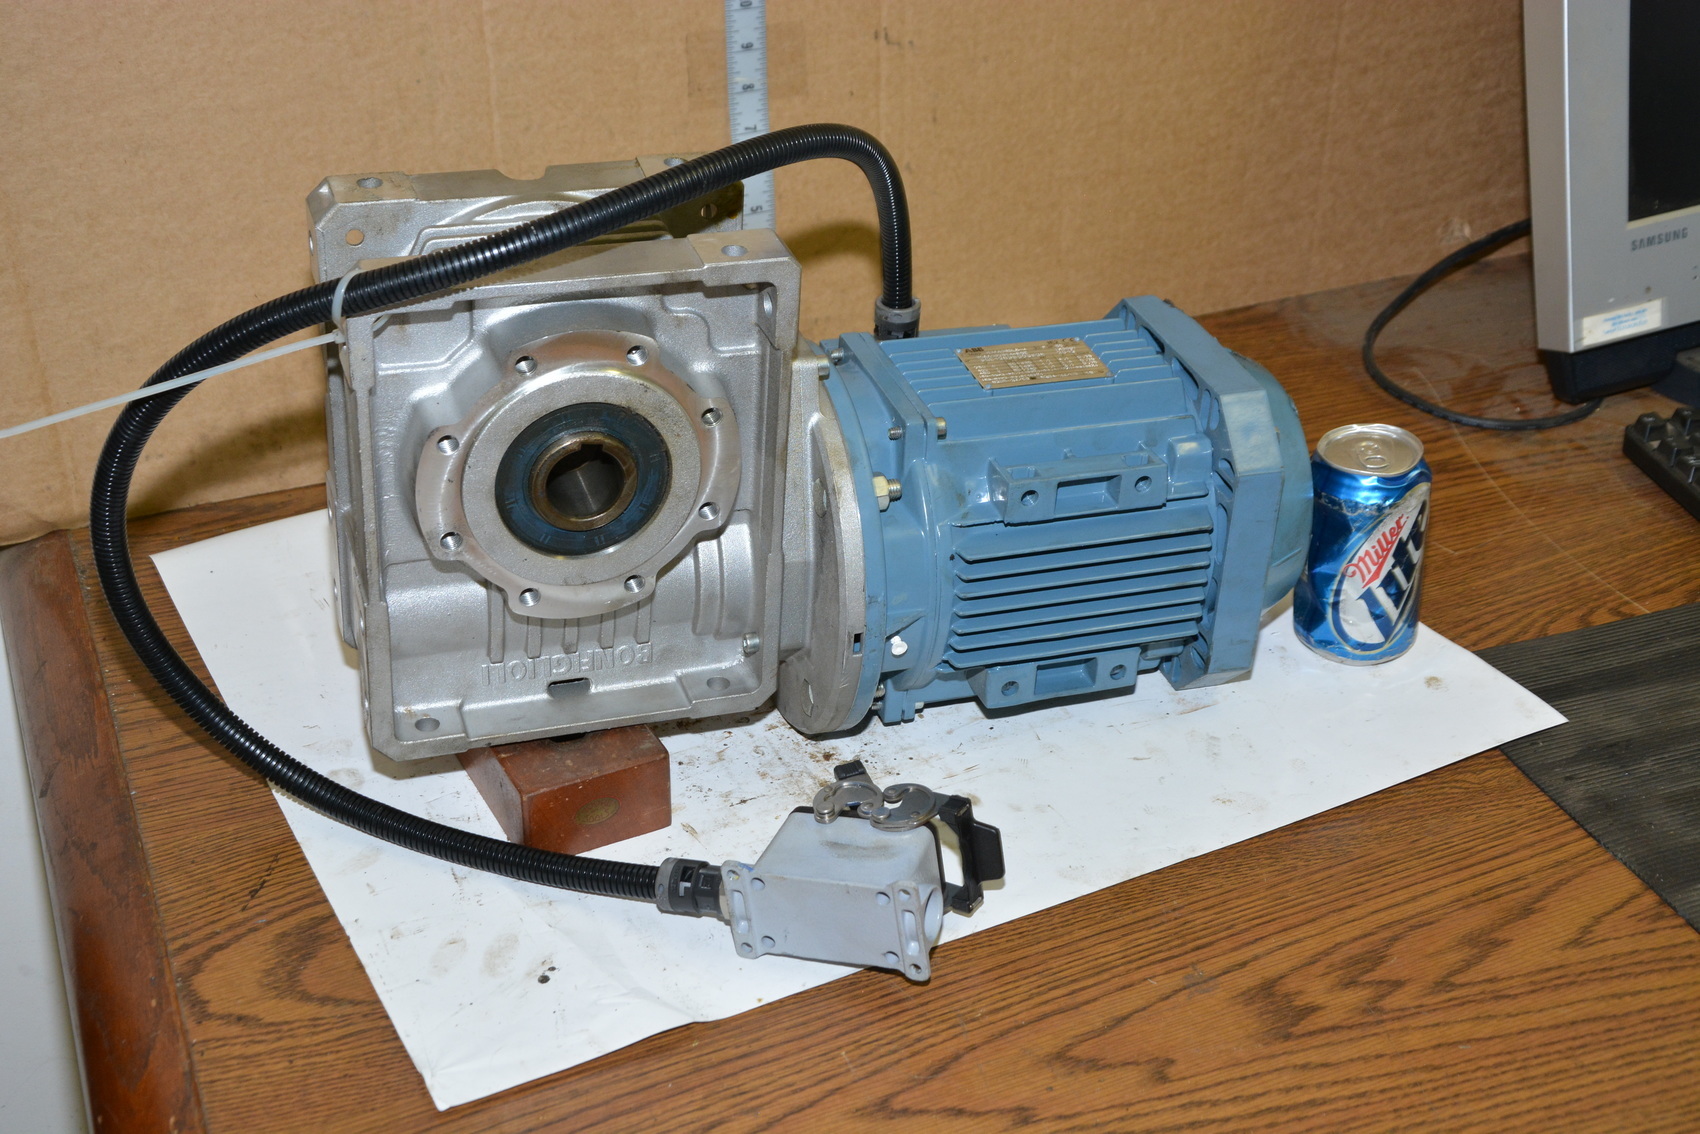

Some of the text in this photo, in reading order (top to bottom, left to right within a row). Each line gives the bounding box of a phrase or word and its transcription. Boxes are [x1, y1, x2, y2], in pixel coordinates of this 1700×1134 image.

[742, 83, 755, 91] 8
[745, 124, 757, 132] 7
[750, 205, 763, 213] 5
[1631, 227, 1688, 251] SAMSUNG
[1343, 513, 1405, 589] Miller
[481, 643, 653, 686] BONFIGLIOLI
